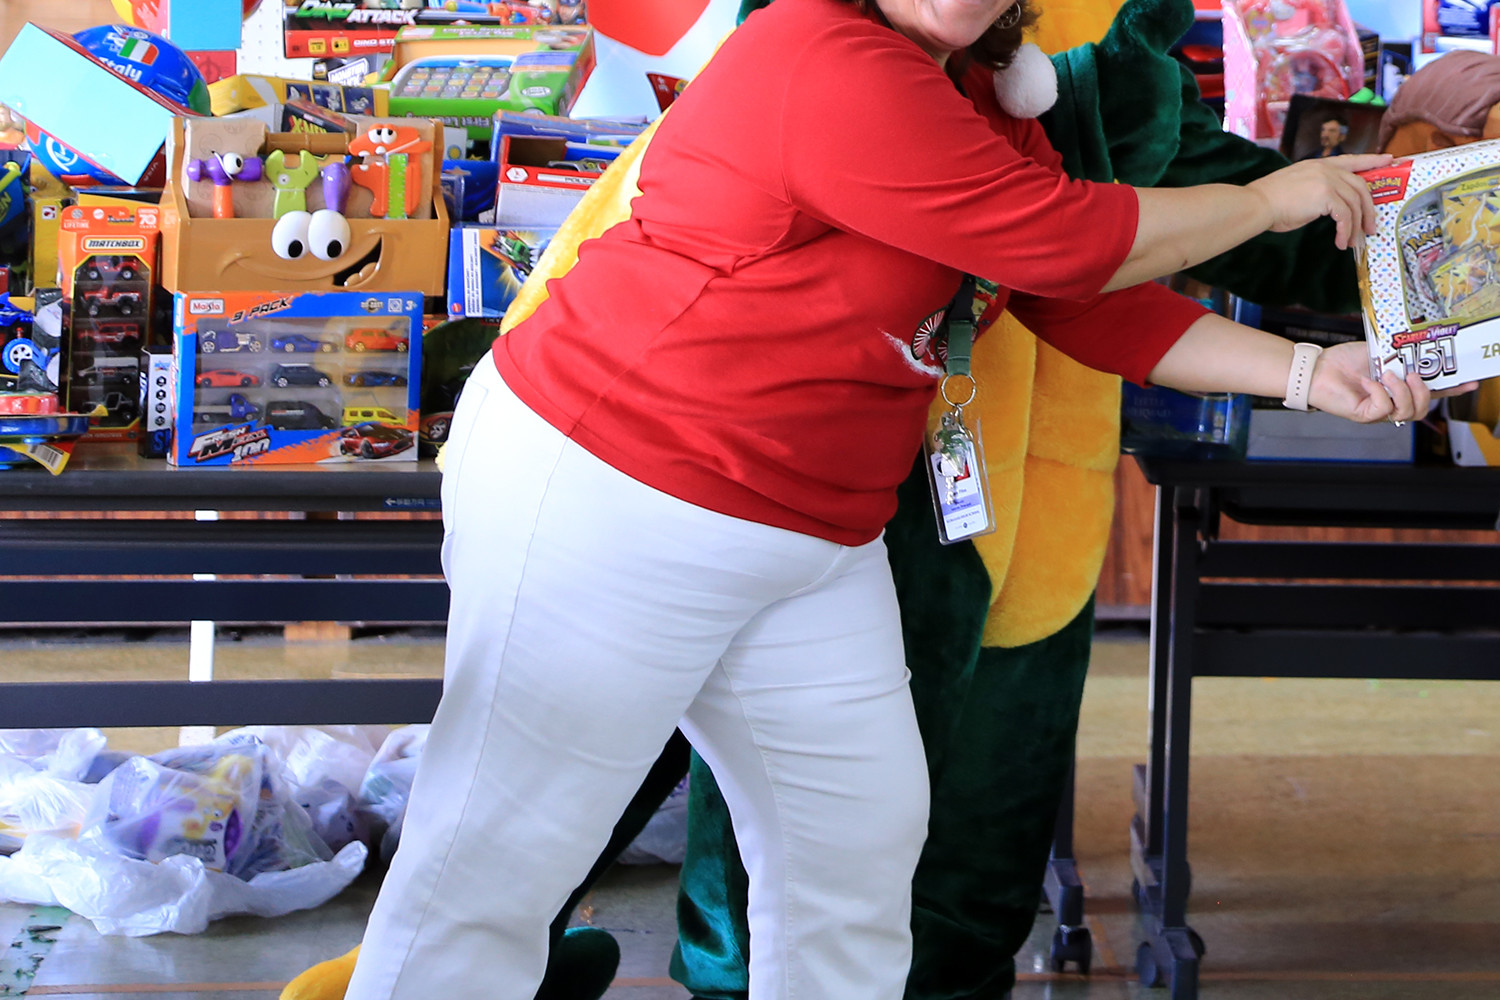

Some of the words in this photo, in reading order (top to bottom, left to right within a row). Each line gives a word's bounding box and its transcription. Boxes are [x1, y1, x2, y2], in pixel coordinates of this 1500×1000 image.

[346, 8, 418, 25] ATTACK
[88, 239, 141, 248] MATCHBOX
[193, 302, 222, 311] Maisto
[248, 297, 291, 318] PACK
[1397, 336, 1458, 381] 151
